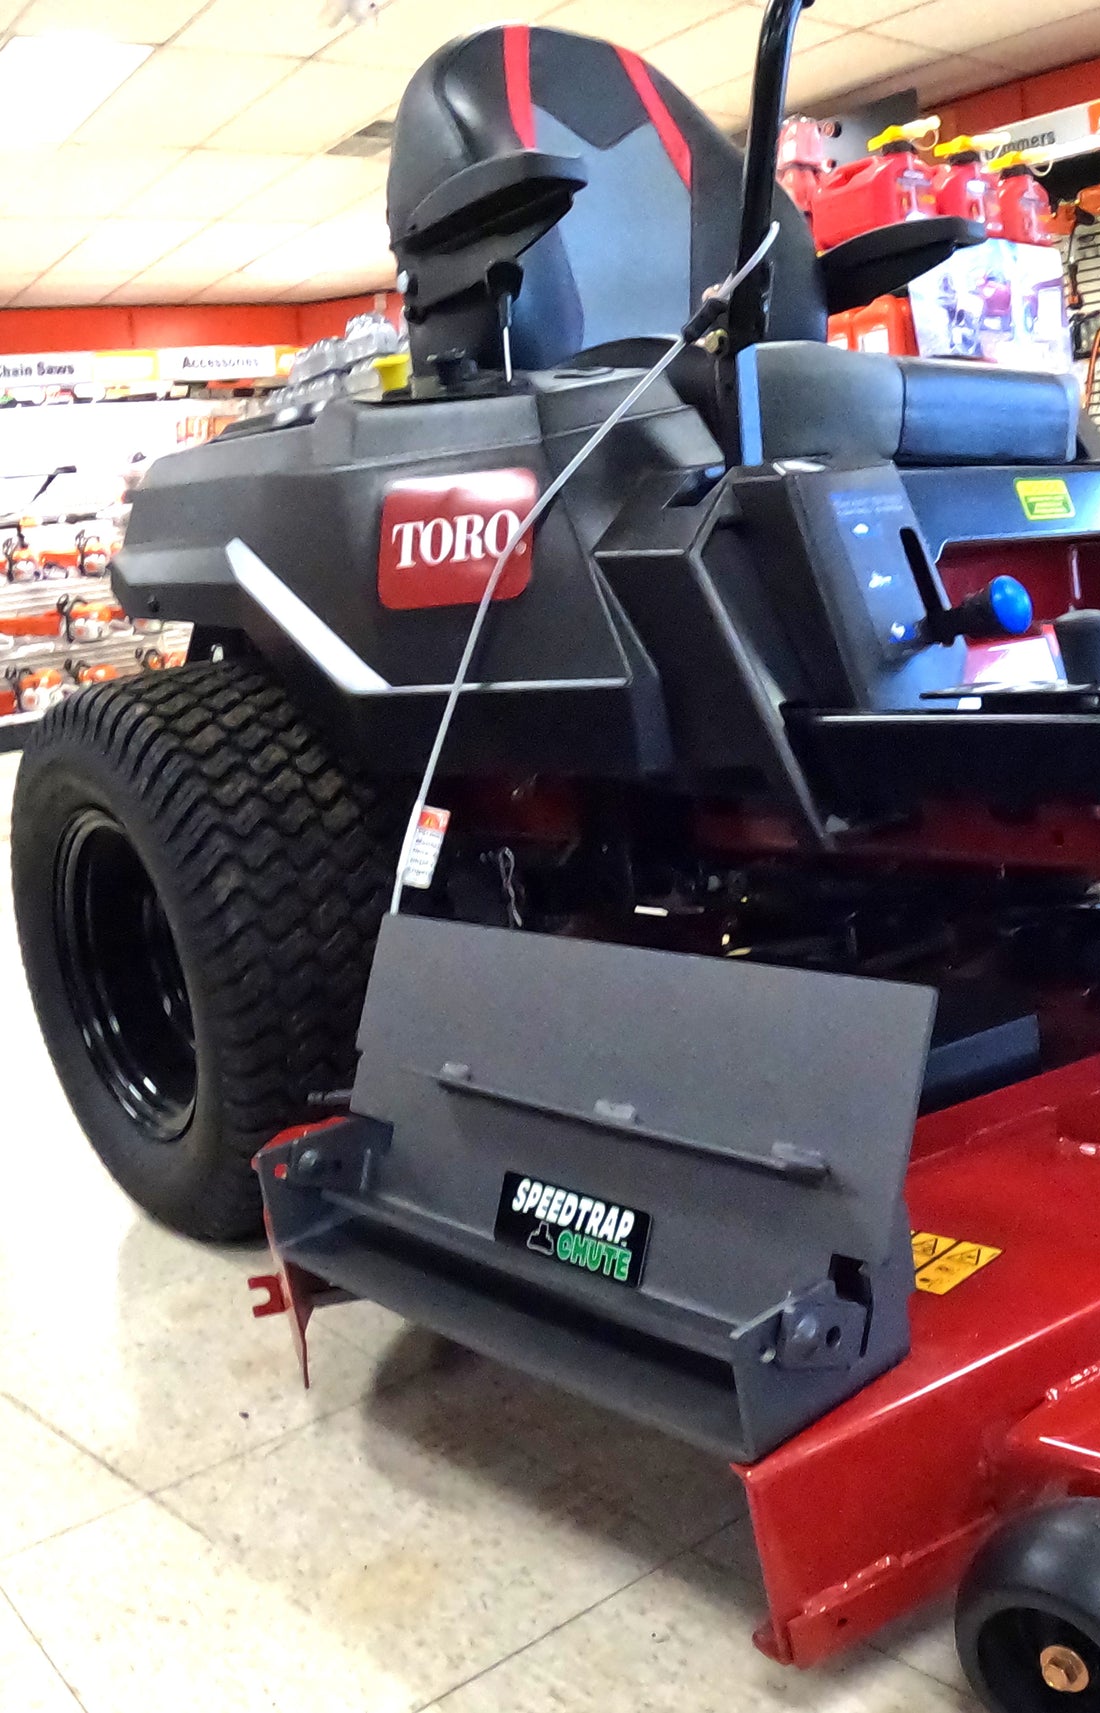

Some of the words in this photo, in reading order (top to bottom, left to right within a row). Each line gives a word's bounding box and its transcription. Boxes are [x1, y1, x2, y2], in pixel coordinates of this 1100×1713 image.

[391, 508, 520, 570] TORO
[511, 1177, 636, 1244] SPEEDTRAP
[556, 1229, 633, 1282] CHUTE
